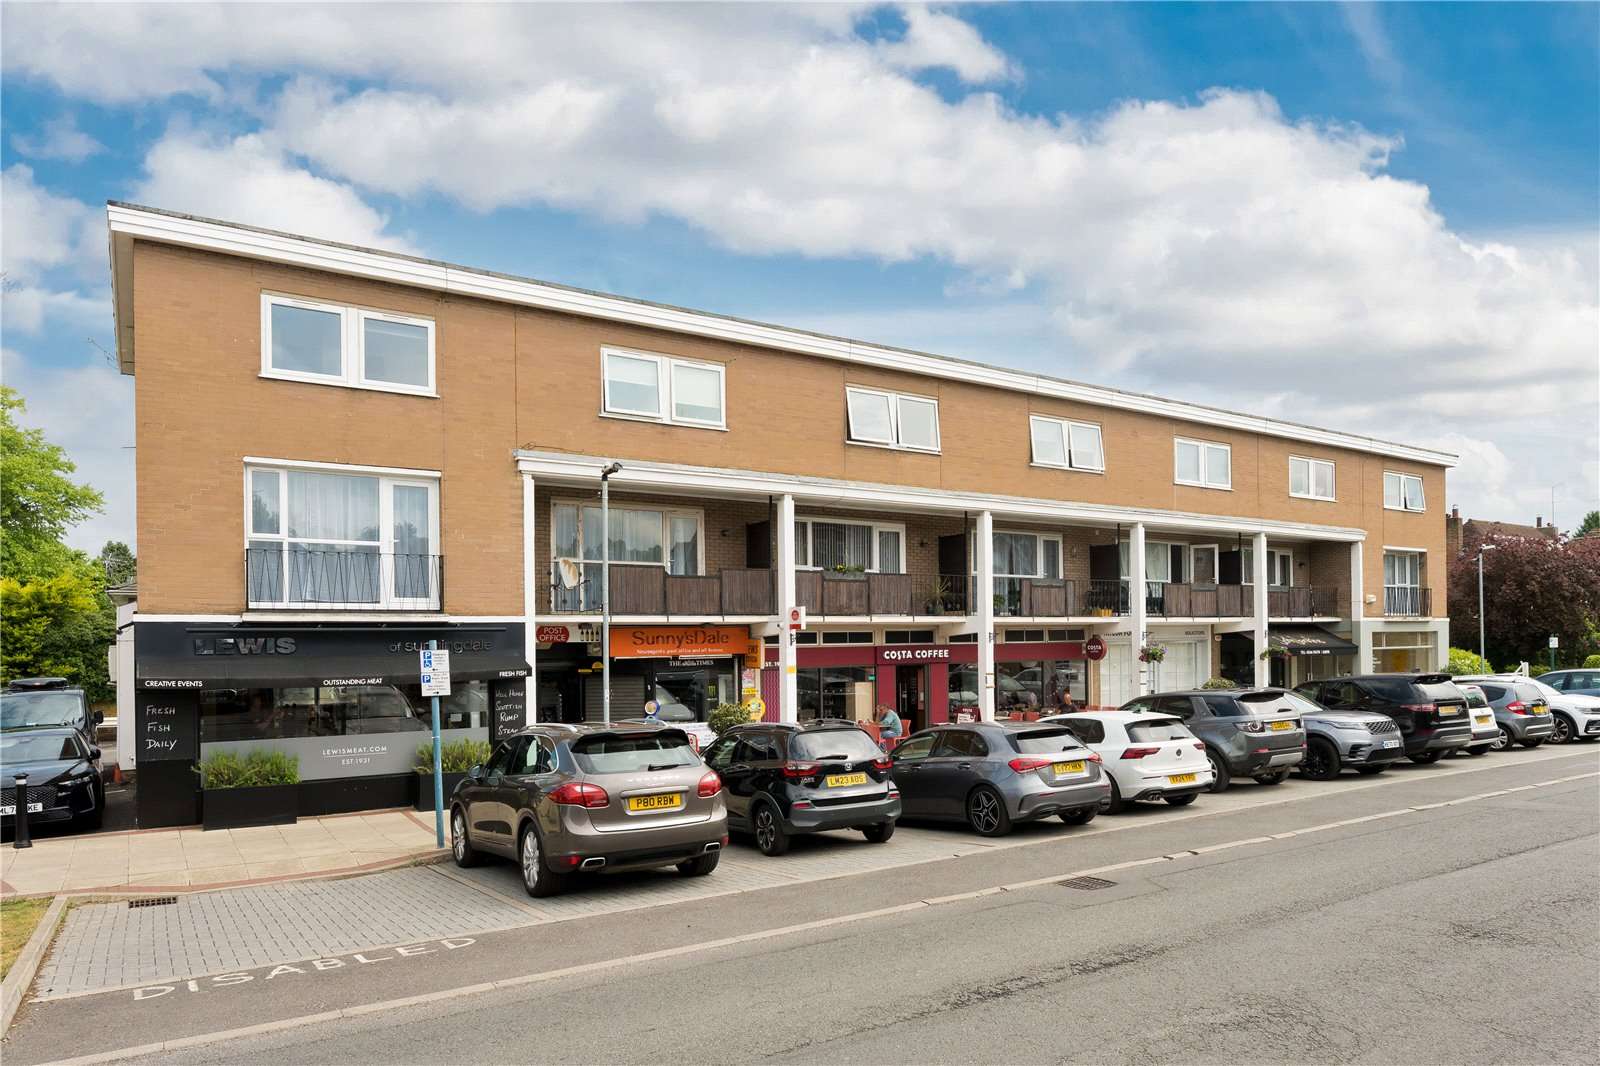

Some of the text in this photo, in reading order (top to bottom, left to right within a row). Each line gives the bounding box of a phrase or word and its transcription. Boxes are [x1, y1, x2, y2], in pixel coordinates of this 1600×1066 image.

[543, 626, 563, 635] POST
[539, 634, 567, 642] OFFICE
[632, 630, 729, 649] Sunny'sDale
[194, 636, 296, 655] LEWIS
[389, 640, 402, 652] of
[884, 650, 950, 660] COSTA COFFEE
[323, 678, 366, 686] OUTSTANDING
[500, 712, 519, 722] RUMP
[145, 738, 177, 750] DAILY
[322, 746, 387, 756] LEWISMEAT.COM
[636, 796, 674, 808] P80 RBW
[133, 937, 477, 1001] DISABLED
